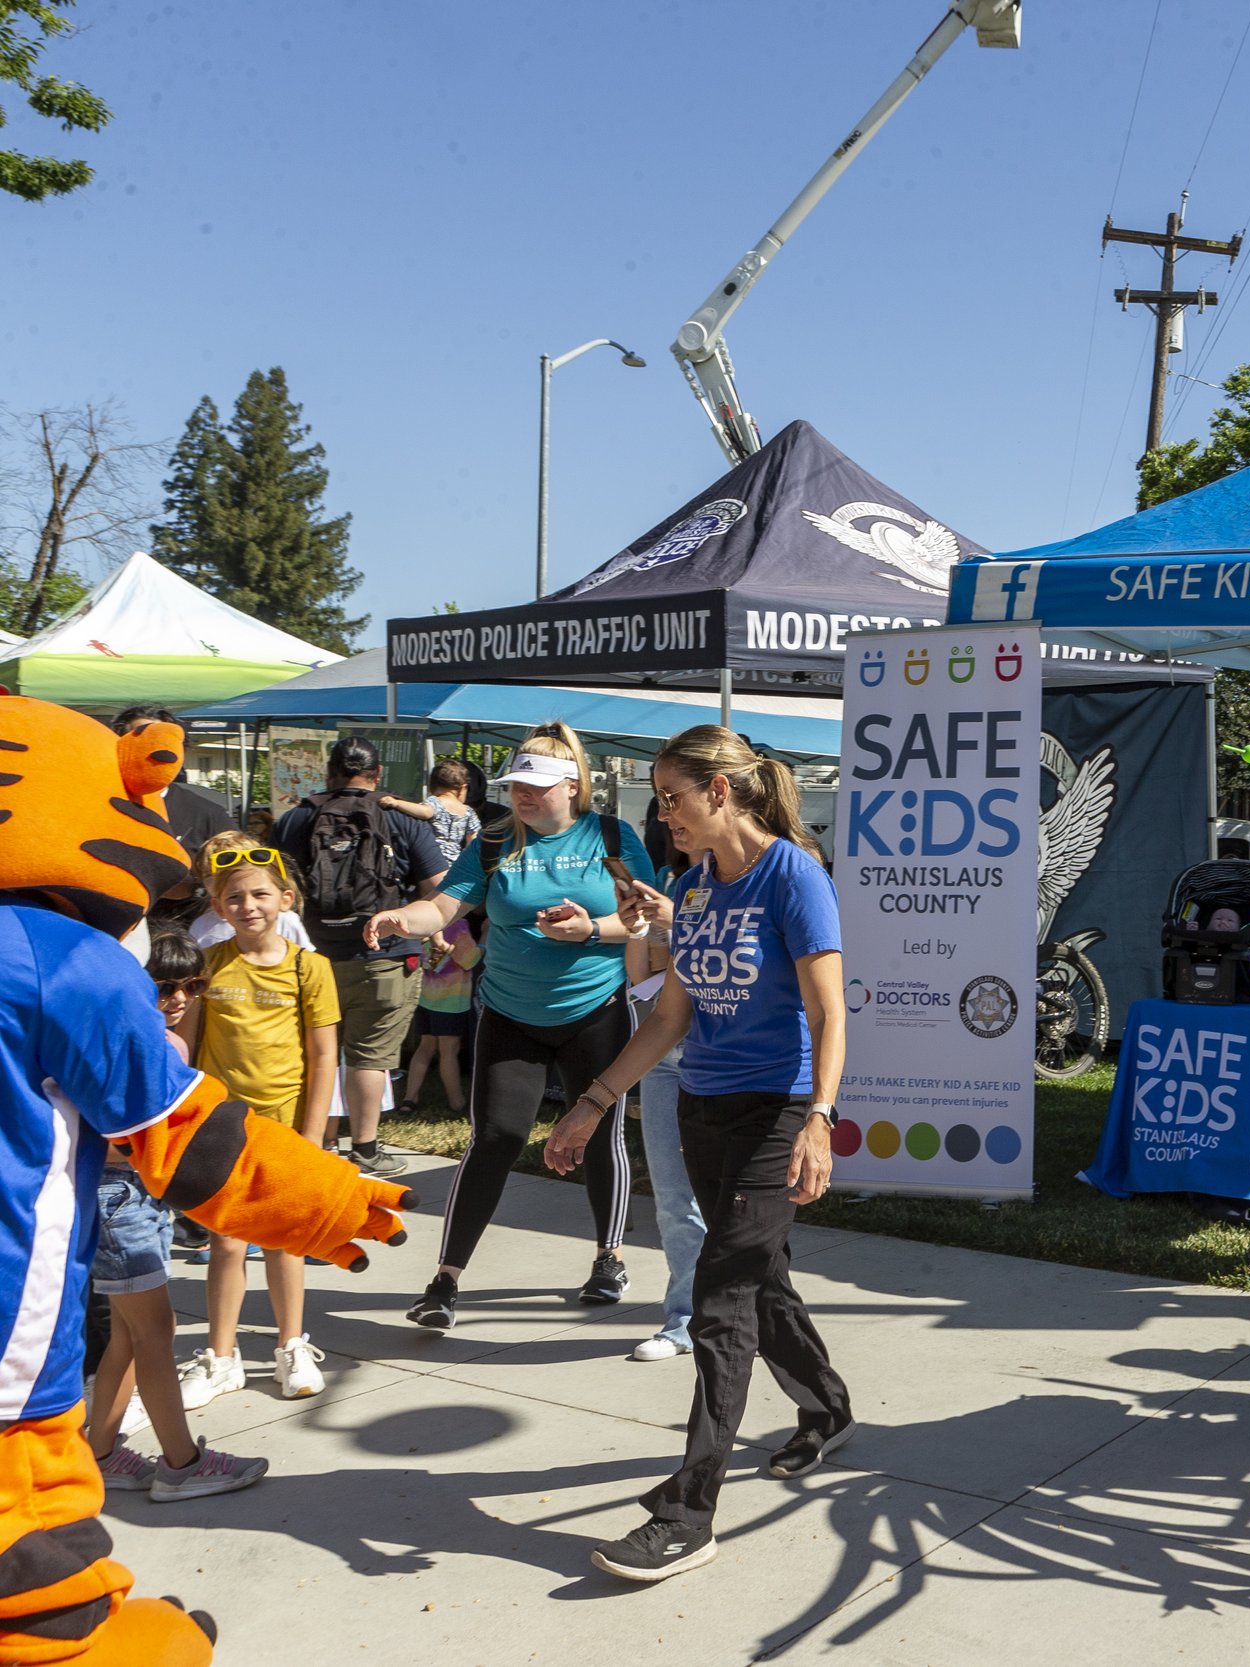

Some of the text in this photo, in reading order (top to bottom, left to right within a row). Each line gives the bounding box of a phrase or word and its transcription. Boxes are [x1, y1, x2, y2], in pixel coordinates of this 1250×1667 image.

[1105, 563, 1206, 601] SAFE
[392, 610, 711, 666] MODESTO POLICE TRAFFIC UNIT
[852, 710, 1022, 781] SAFE
[1040, 736, 1069, 782] OLICE
[555, 856, 601, 870] SURGEY
[859, 866, 1003, 887] STANISLAUS
[879, 894, 981, 914] COUNTY
[678, 907, 765, 945] SAFE
[903, 938, 957, 960] Led by
[876, 980, 929, 991] Central Valley
[876, 991, 951, 1006] DOCTORS
[1136, 1024, 1248, 1081] SAFE
[840, 1076, 1021, 1092] ELP US MAKE EVERY KID A SAFE KID
[840, 1092, 1009, 1109] Learn how you can prevent injuries
[1133, 1127, 1220, 1149] STANISLAUS
[1145, 1147, 1200, 1162] COUNTY
